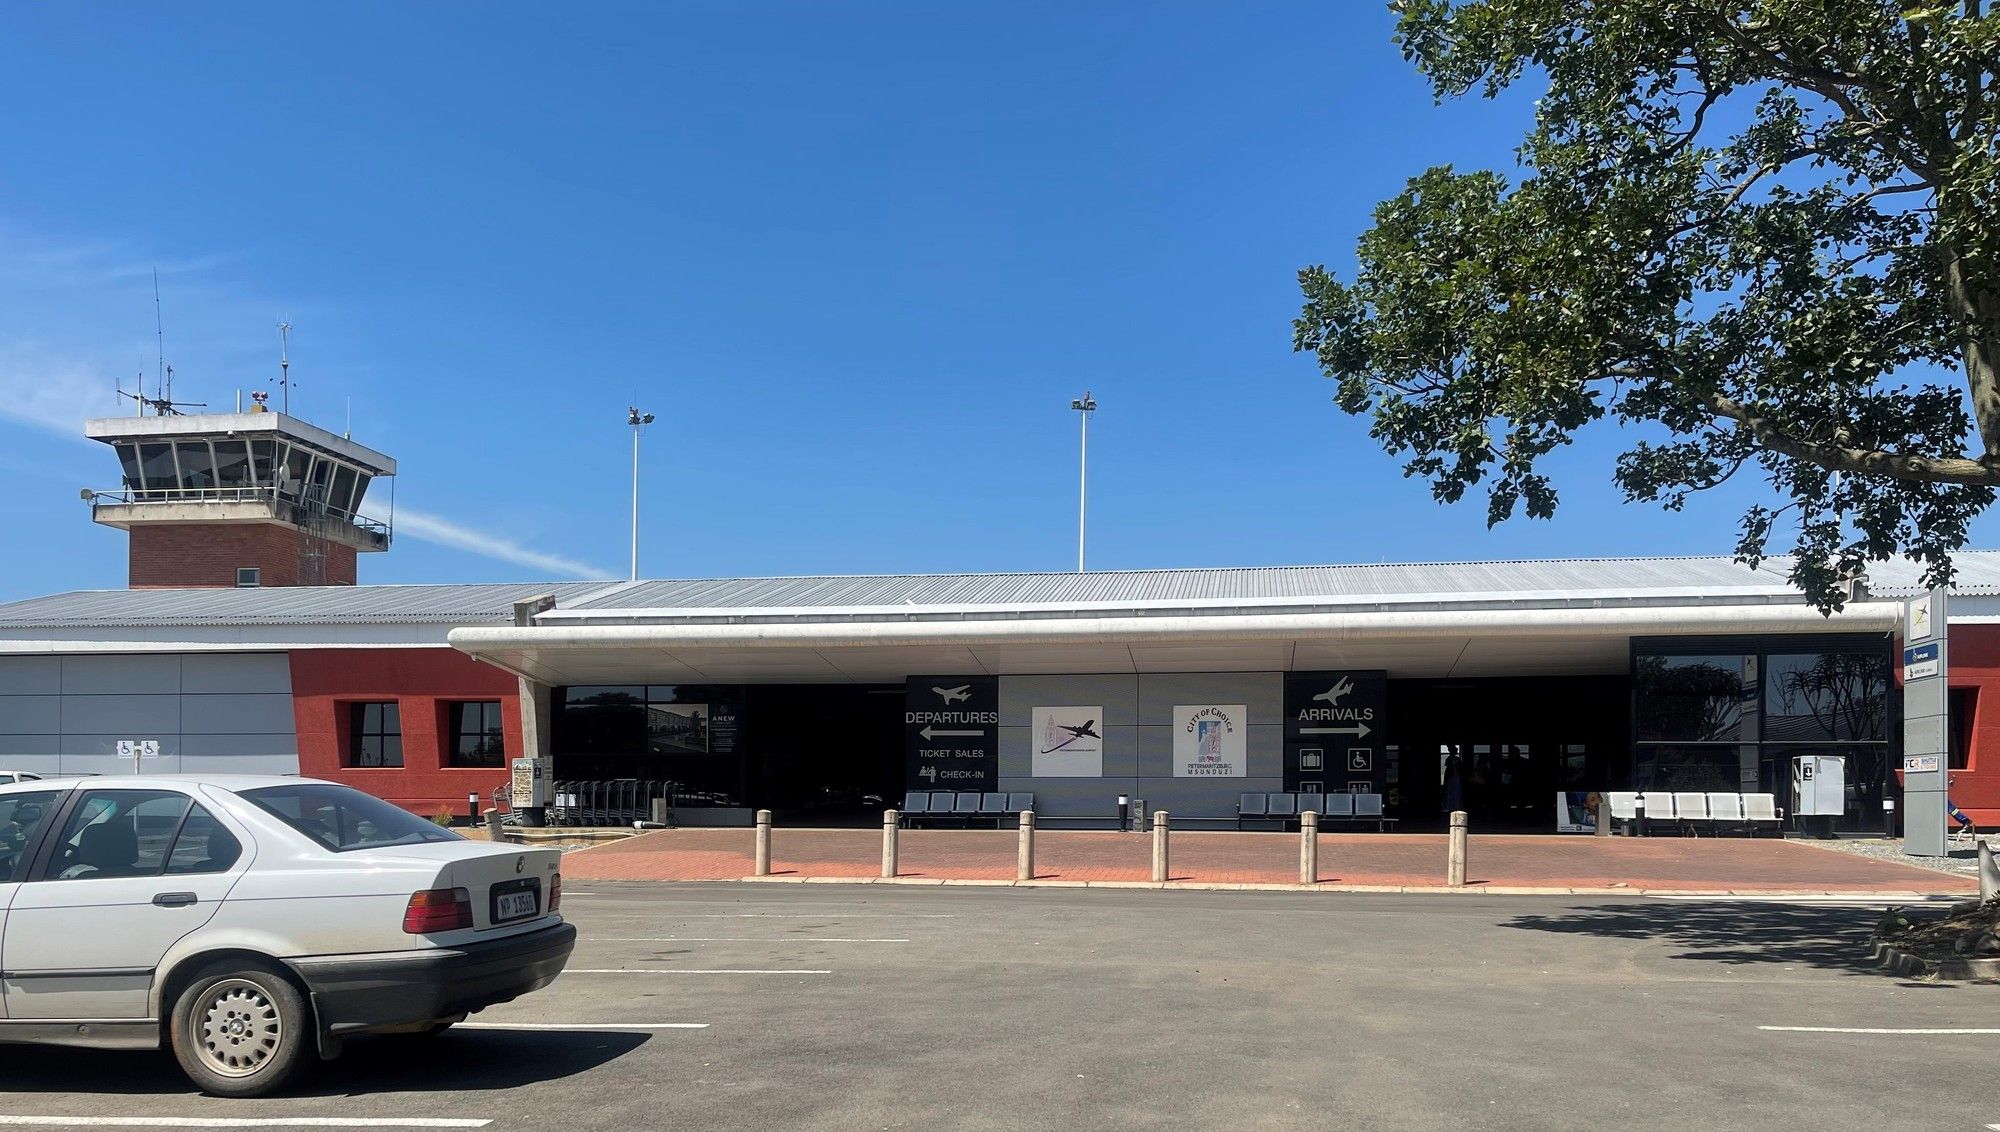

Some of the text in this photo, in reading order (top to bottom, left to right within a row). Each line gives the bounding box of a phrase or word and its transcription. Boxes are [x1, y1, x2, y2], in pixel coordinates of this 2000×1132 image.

[905, 711, 998, 724] DEPARTURES
[1187, 707, 1233, 733] CITY OF CHOICE
[1298, 708, 1374, 721] ARRIVALS
[919, 750, 984, 758] TICKET SALES
[940, 770, 985, 779] CHECK-IN
